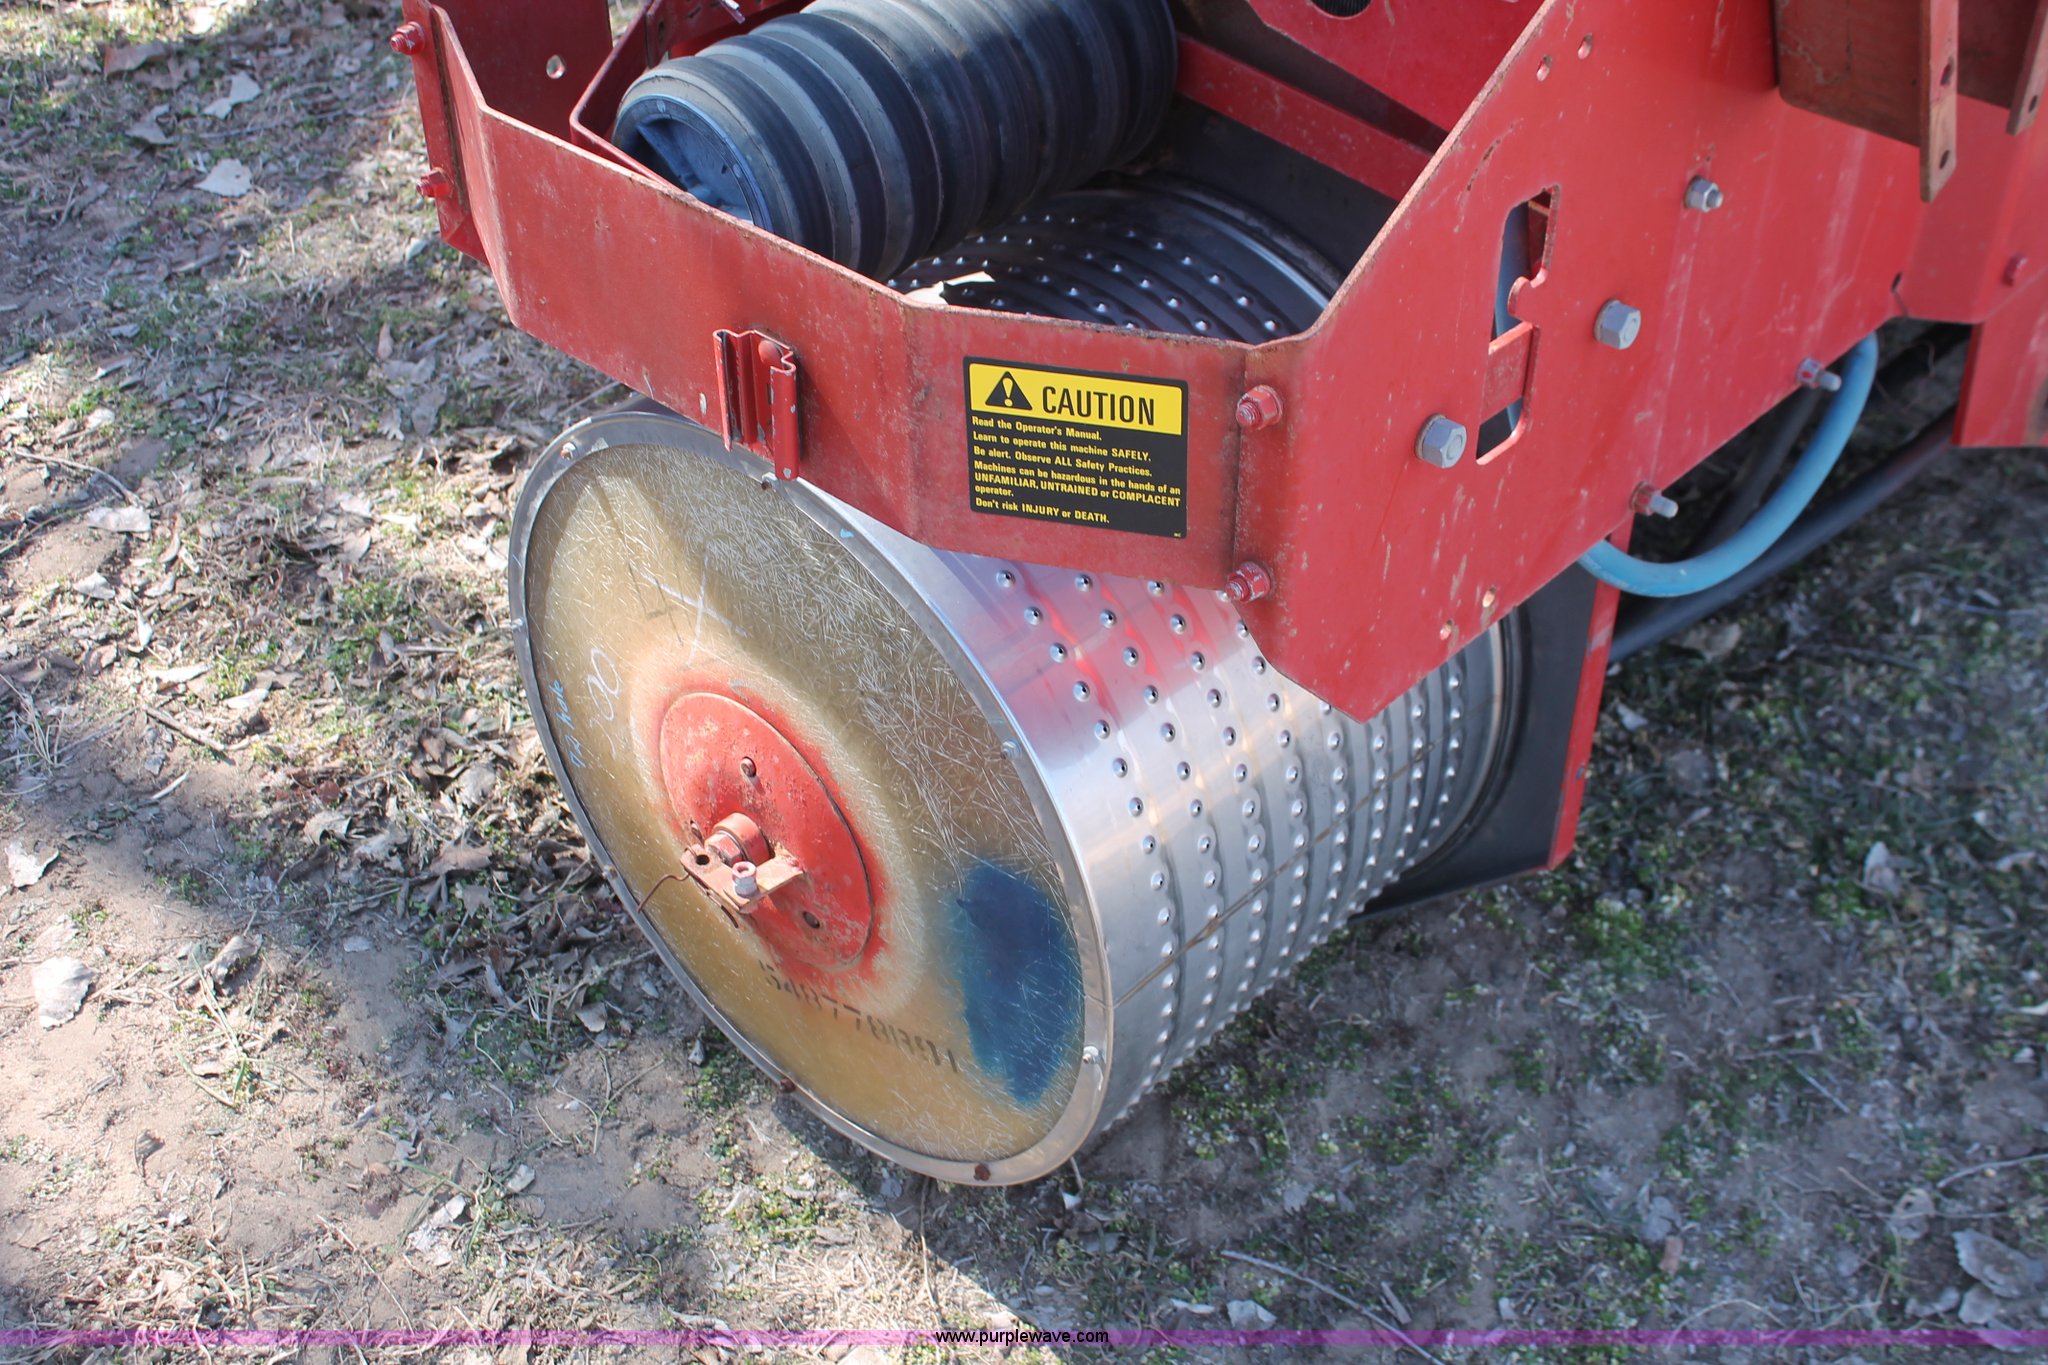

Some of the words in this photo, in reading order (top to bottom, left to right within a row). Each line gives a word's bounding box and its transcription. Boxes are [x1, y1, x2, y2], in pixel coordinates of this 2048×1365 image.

[1042, 385, 1155, 426] CAUTION
[972, 416, 994, 428] Read
[997, 419, 1012, 430] the
[1015, 421, 1062, 435] Operator's
[1066, 428, 1102, 440] Manual.
[973, 431, 997, 443] Learn
[999, 434, 1010, 444] to
[1013, 437, 1046, 450] operate
[1050, 440, 1067, 452] this
[1070, 442, 1108, 456] machine
[1111, 448, 1152, 461] SAFELY.
[974, 446, 986, 456] Be
[988, 448, 1011, 459] alert.
[1015, 451, 1051, 464] Observe
[1055, 456, 1072, 467] ALL
[1076, 458, 1104, 473] Safety
[1109, 462, 1152, 477] Practices.
[974, 460, 1016, 474] Machines
[1019, 466, 1034, 476] can
[1037, 467, 1048, 478] be
[1051, 469, 1096, 484] hazardous
[1099, 474, 1108, 485] in
[1110, 476, 1125, 488] the
[1128, 478, 1155, 492] hands
[1158, 481, 1168, 493] of
[1170, 485, 1181, 495] an
[975, 473, 1039, 490] UNFAMILIAR,
[1041, 480, 1099, 496] UNTRAINED
[1100, 489, 1109, 498] or
[1112, 490, 1181, 507] COMPLACENT
[975, 485, 1014, 497] operator.
[976, 498, 999, 509] Don't
[1002, 500, 1018, 512] risk
[1022, 503, 1059, 517] INJURY
[1061, 509, 1071, 518] or
[1074, 509, 1110, 523] DEATH.
